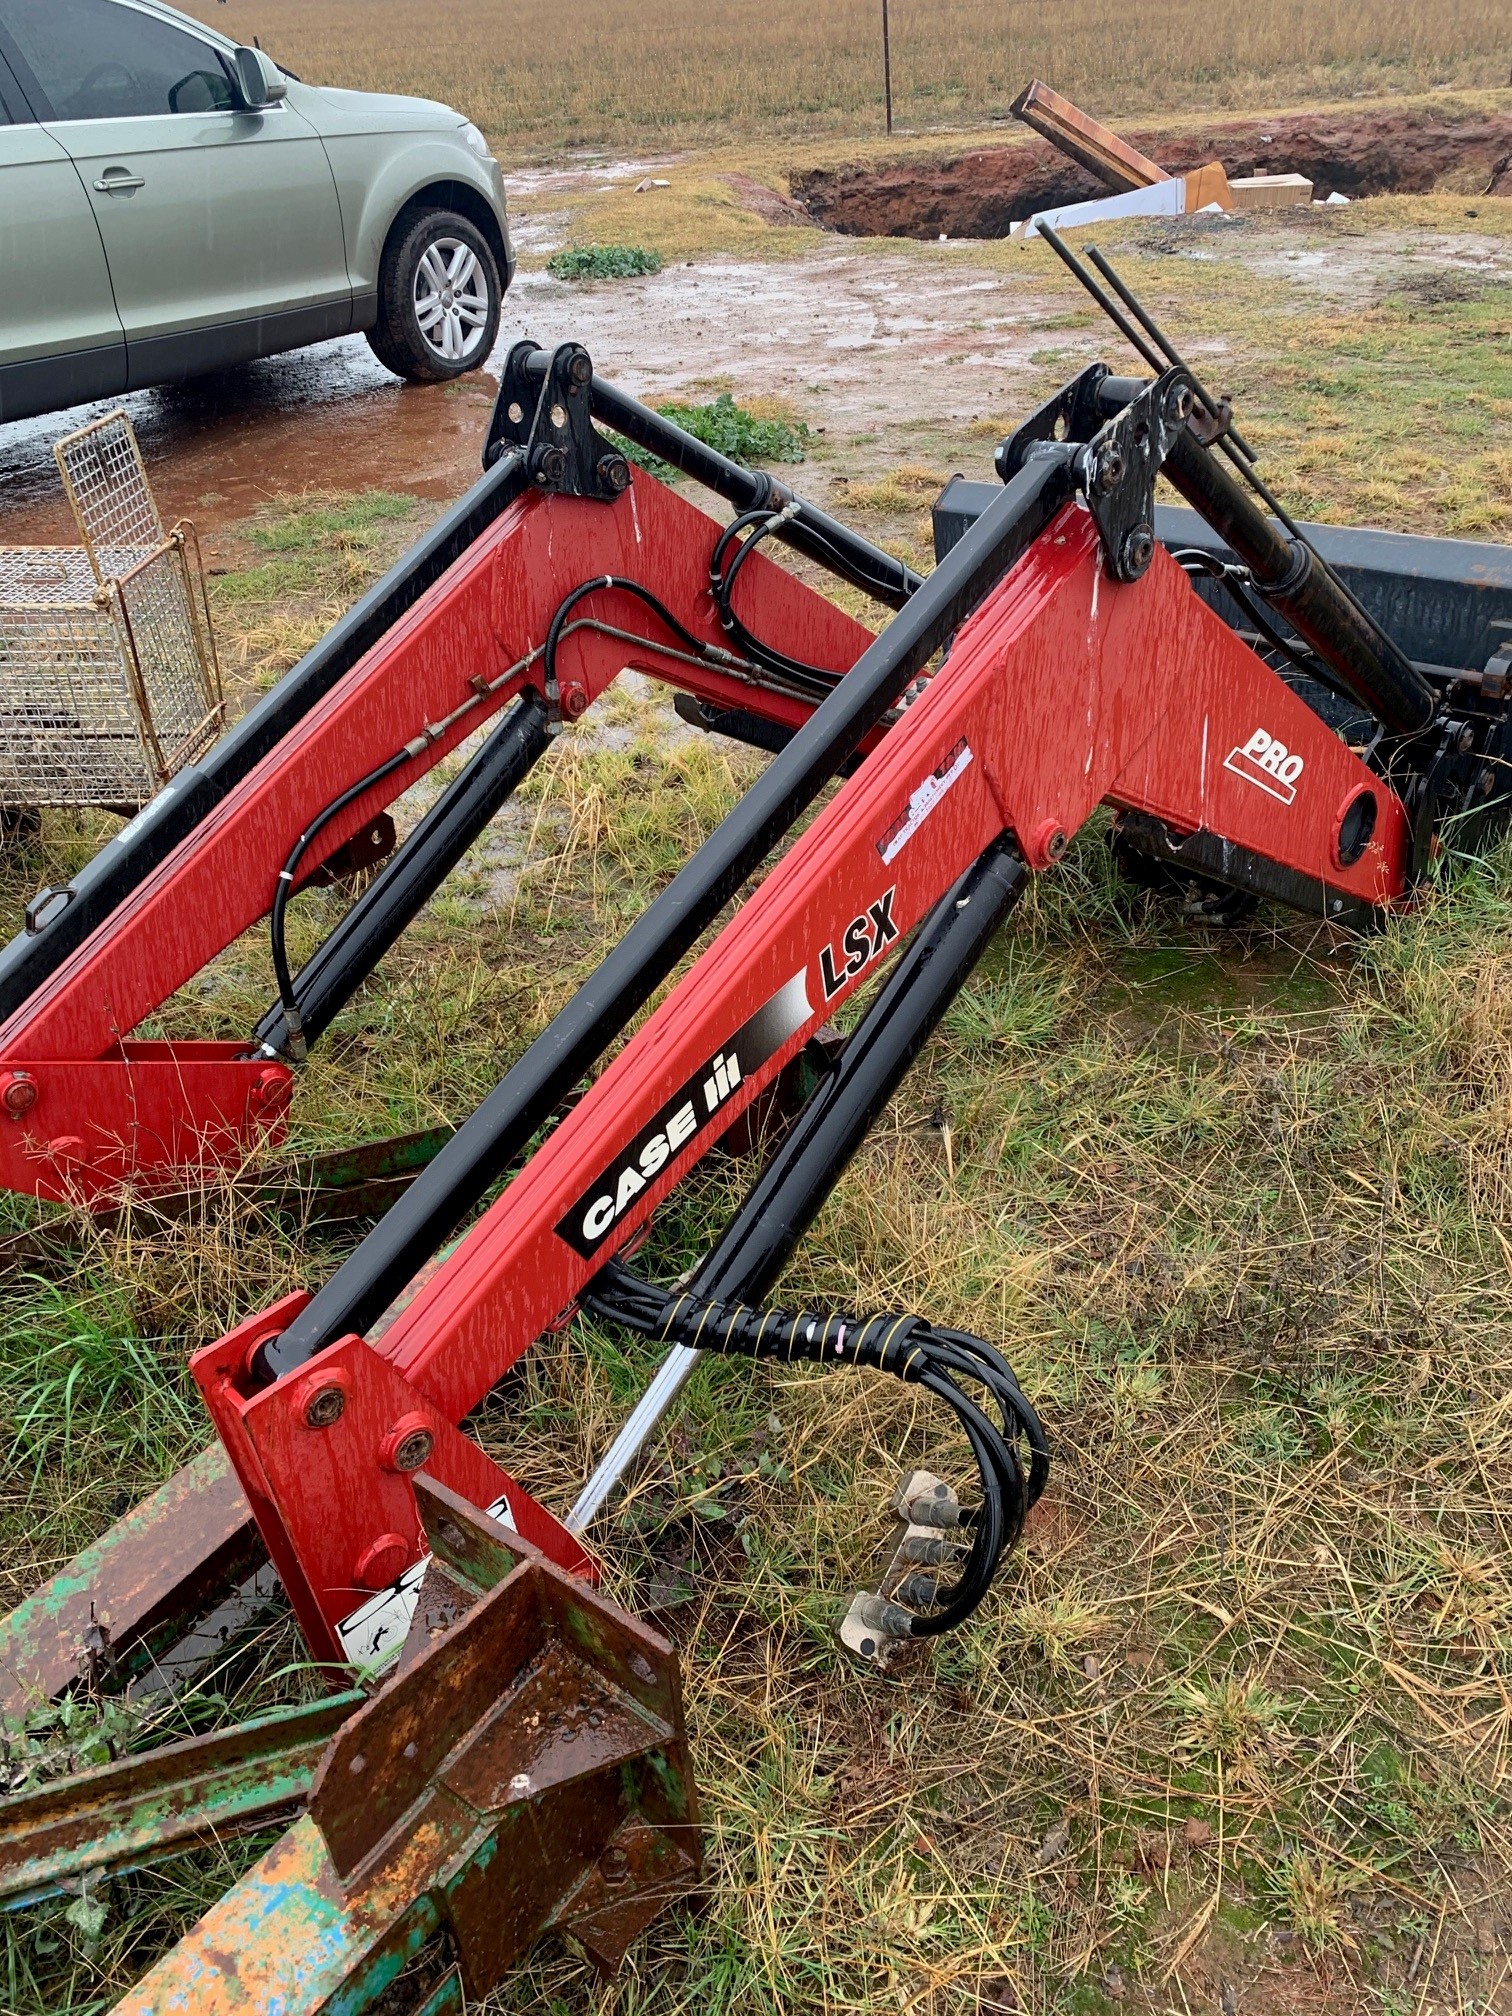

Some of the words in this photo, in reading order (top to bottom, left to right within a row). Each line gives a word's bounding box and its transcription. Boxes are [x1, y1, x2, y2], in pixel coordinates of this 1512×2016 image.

[1241, 727, 1304, 784] PRO
[819, 884, 900, 1003] LSX
[582, 1099, 698, 1240] CASE
